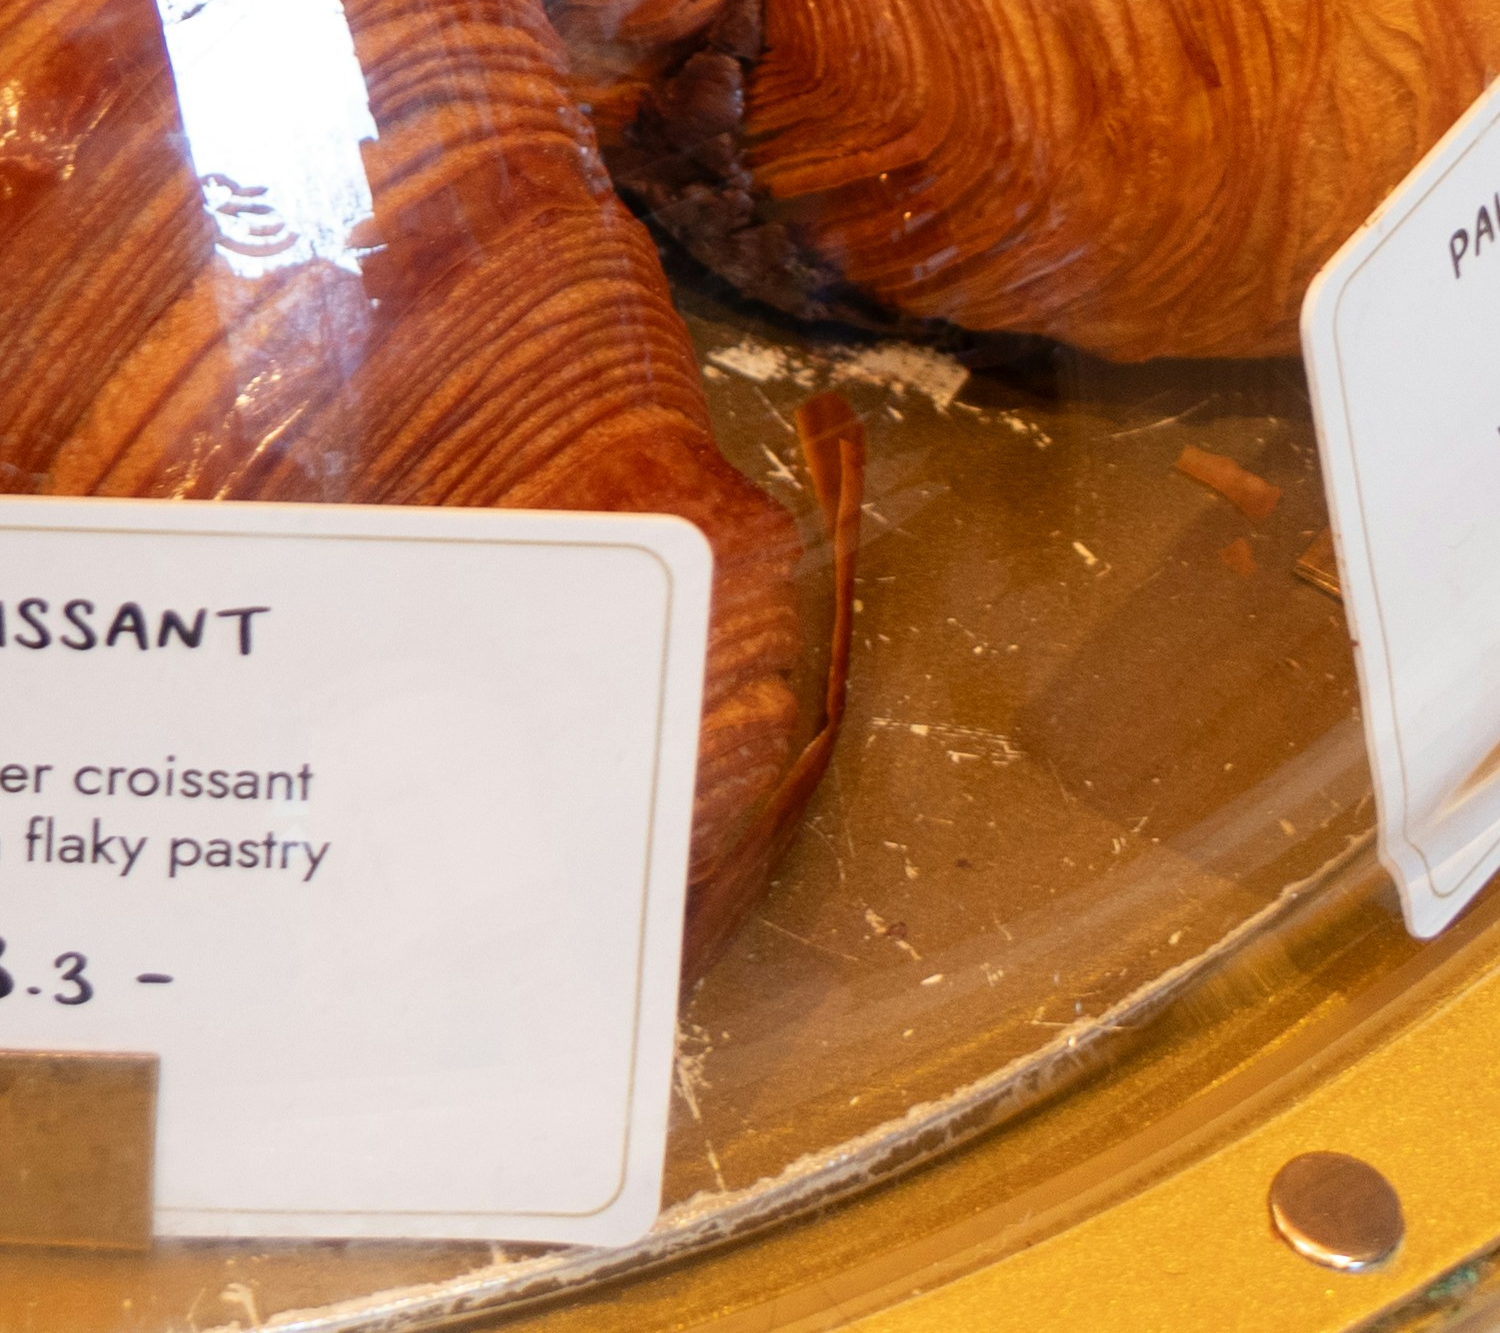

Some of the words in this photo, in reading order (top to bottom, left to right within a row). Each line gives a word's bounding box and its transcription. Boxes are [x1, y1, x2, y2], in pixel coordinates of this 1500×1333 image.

[73, 754, 314, 802] croissant
[25, 815, 149, 877] flaky
[168, 831, 332, 883] pastry
